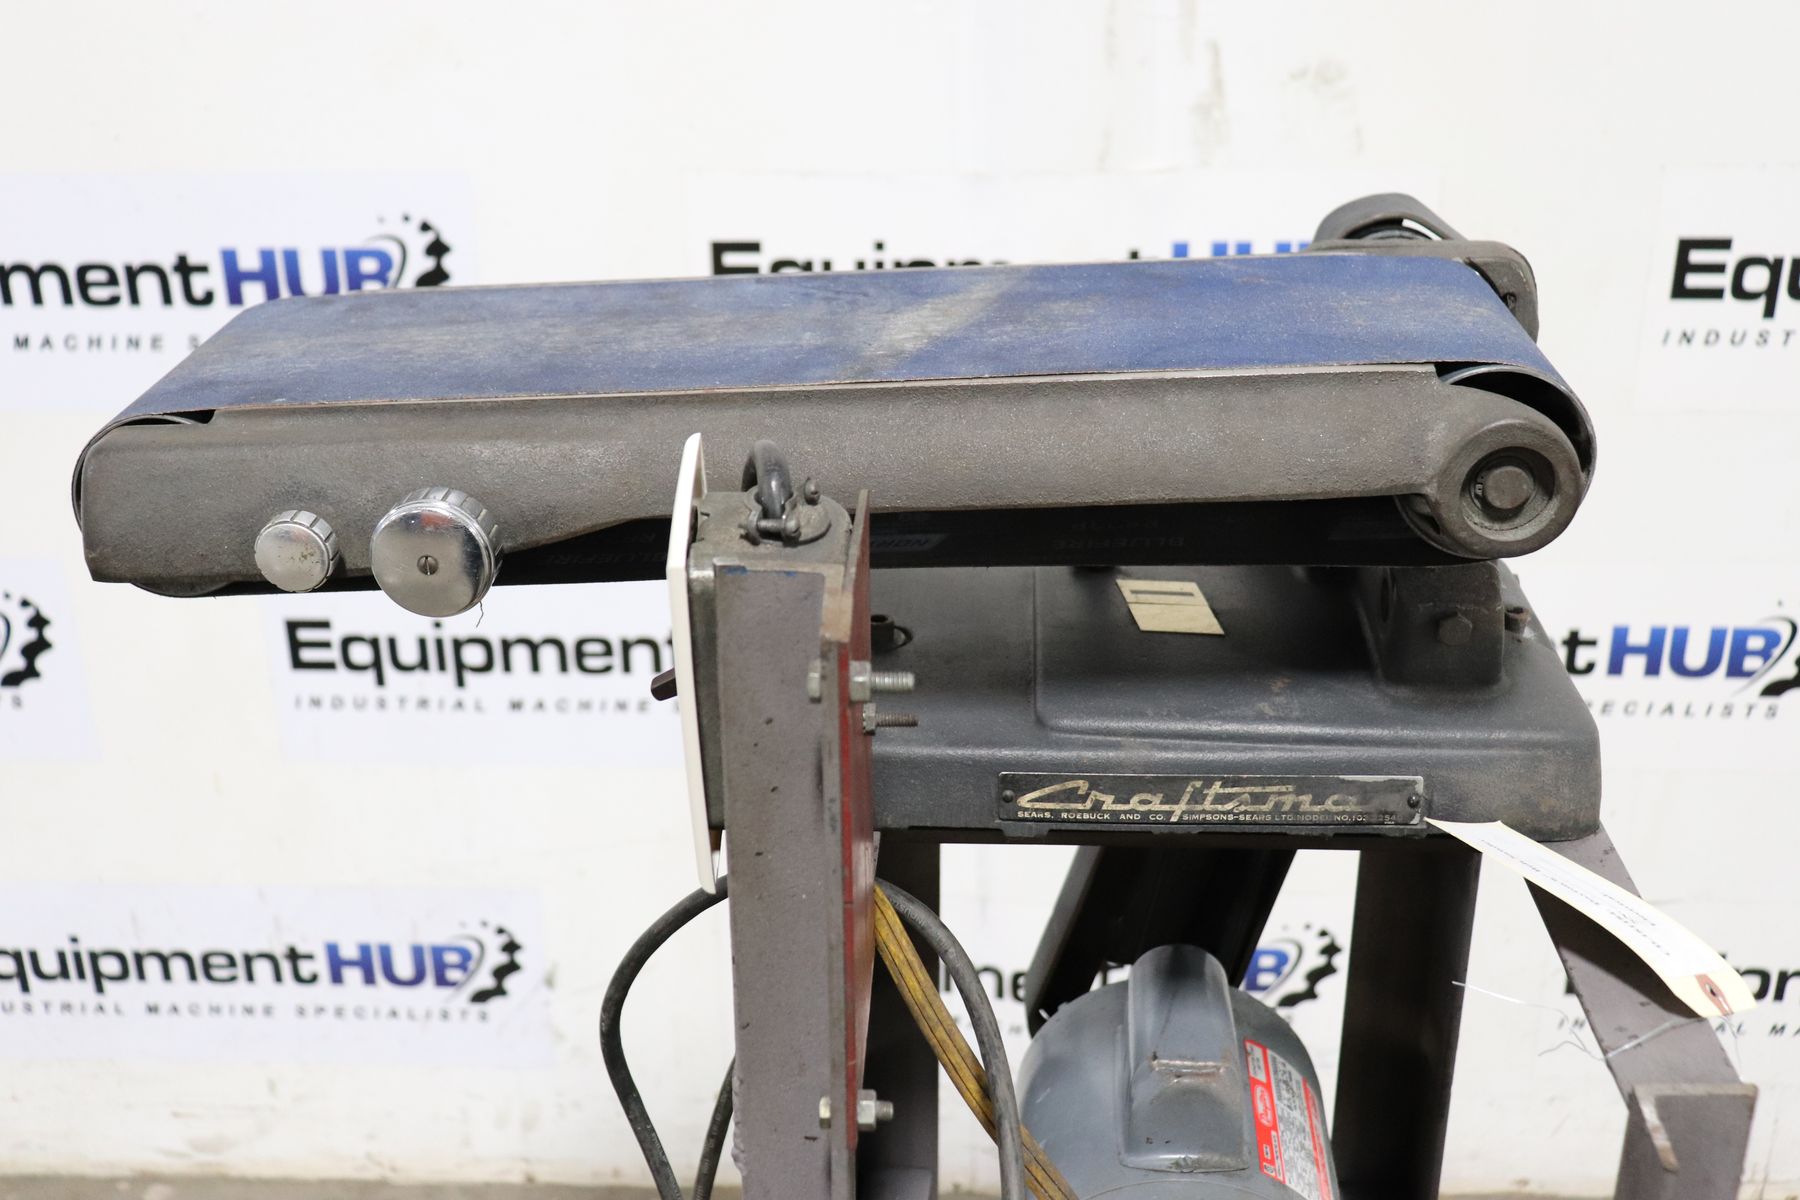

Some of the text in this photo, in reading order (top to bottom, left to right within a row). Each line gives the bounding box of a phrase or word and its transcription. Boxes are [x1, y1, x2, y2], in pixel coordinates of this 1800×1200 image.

[14, 334, 163, 350] MACHINE
[285, 617, 674, 689] Equipmen
[294, 695, 486, 713] INDUSTRIAL
[510, 698, 653, 714] MACHINE
[1061, 812, 1110, 820] ROEBUCK
[1149, 813, 1166, 821] CO.
[145, 1001, 275, 1018] MACHINE
[296, 1005, 489, 1023] SPECIALISTS
